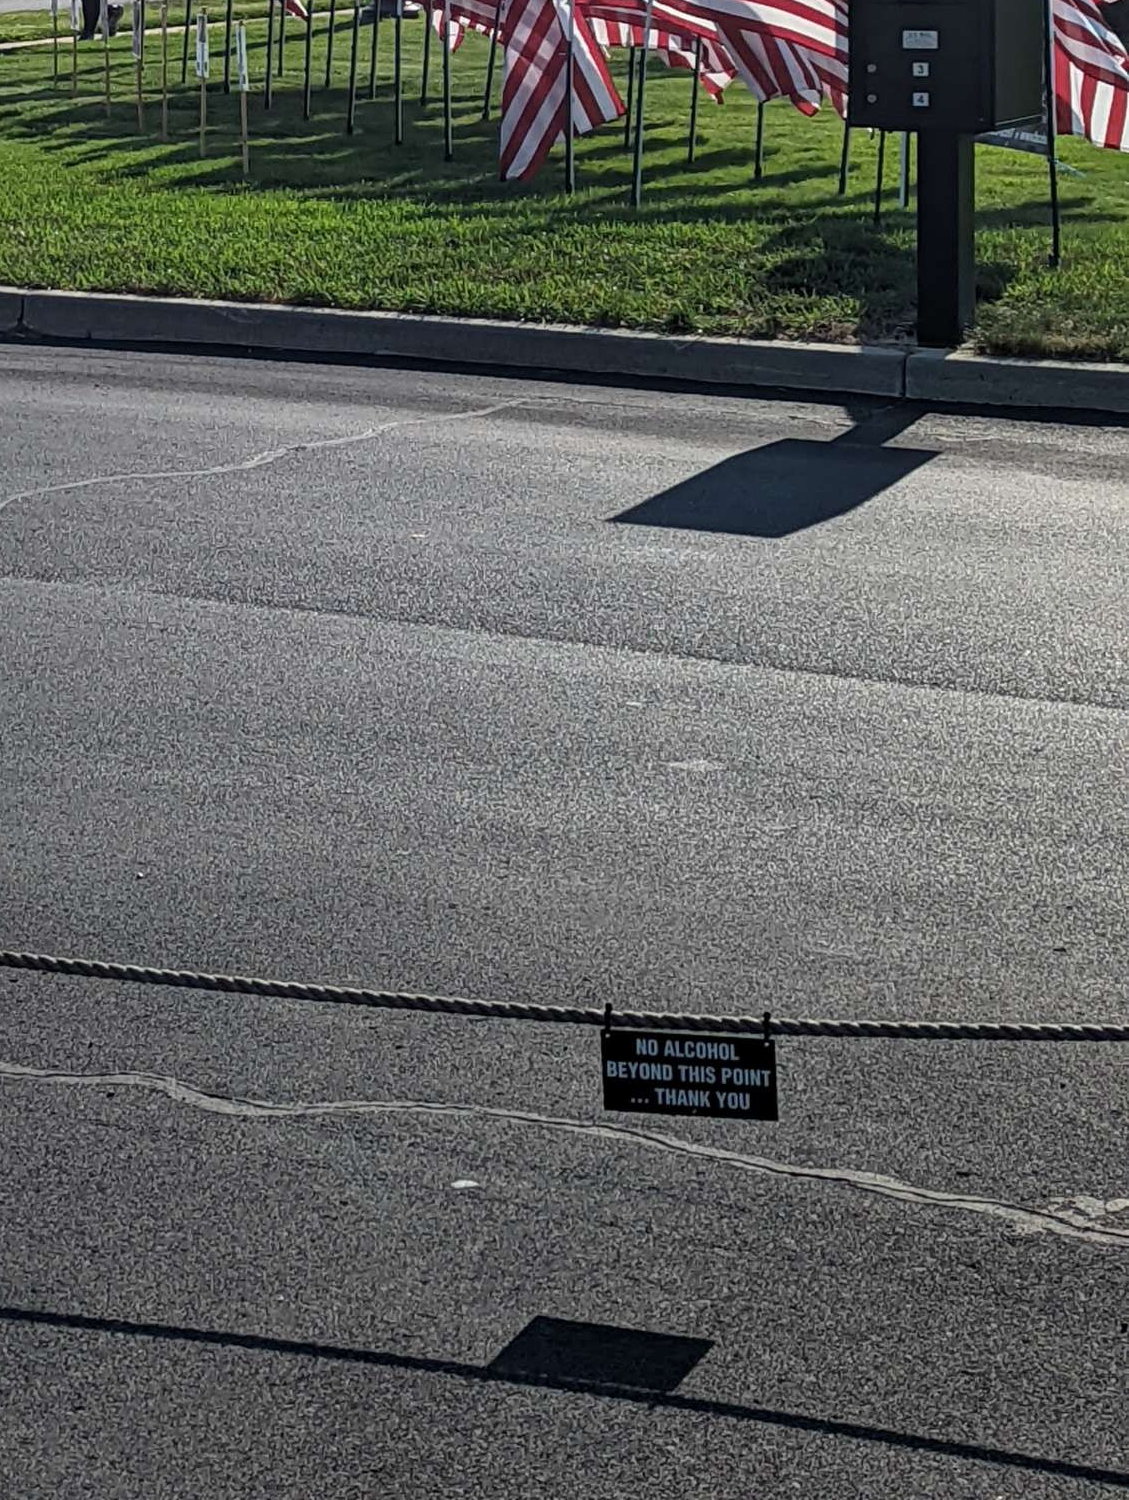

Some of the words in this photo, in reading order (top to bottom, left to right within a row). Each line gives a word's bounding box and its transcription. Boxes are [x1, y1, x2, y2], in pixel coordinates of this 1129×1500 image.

[635, 1038, 659, 1057] NO
[664, 1041, 740, 1061] ALCOHOL
[606, 1060, 673, 1081] BEYOND
[678, 1064, 716, 1084] THIS
[721, 1067, 771, 1087] POINT
[654, 1087, 710, 1108] THANK
[716, 1091, 751, 1110] YOU
